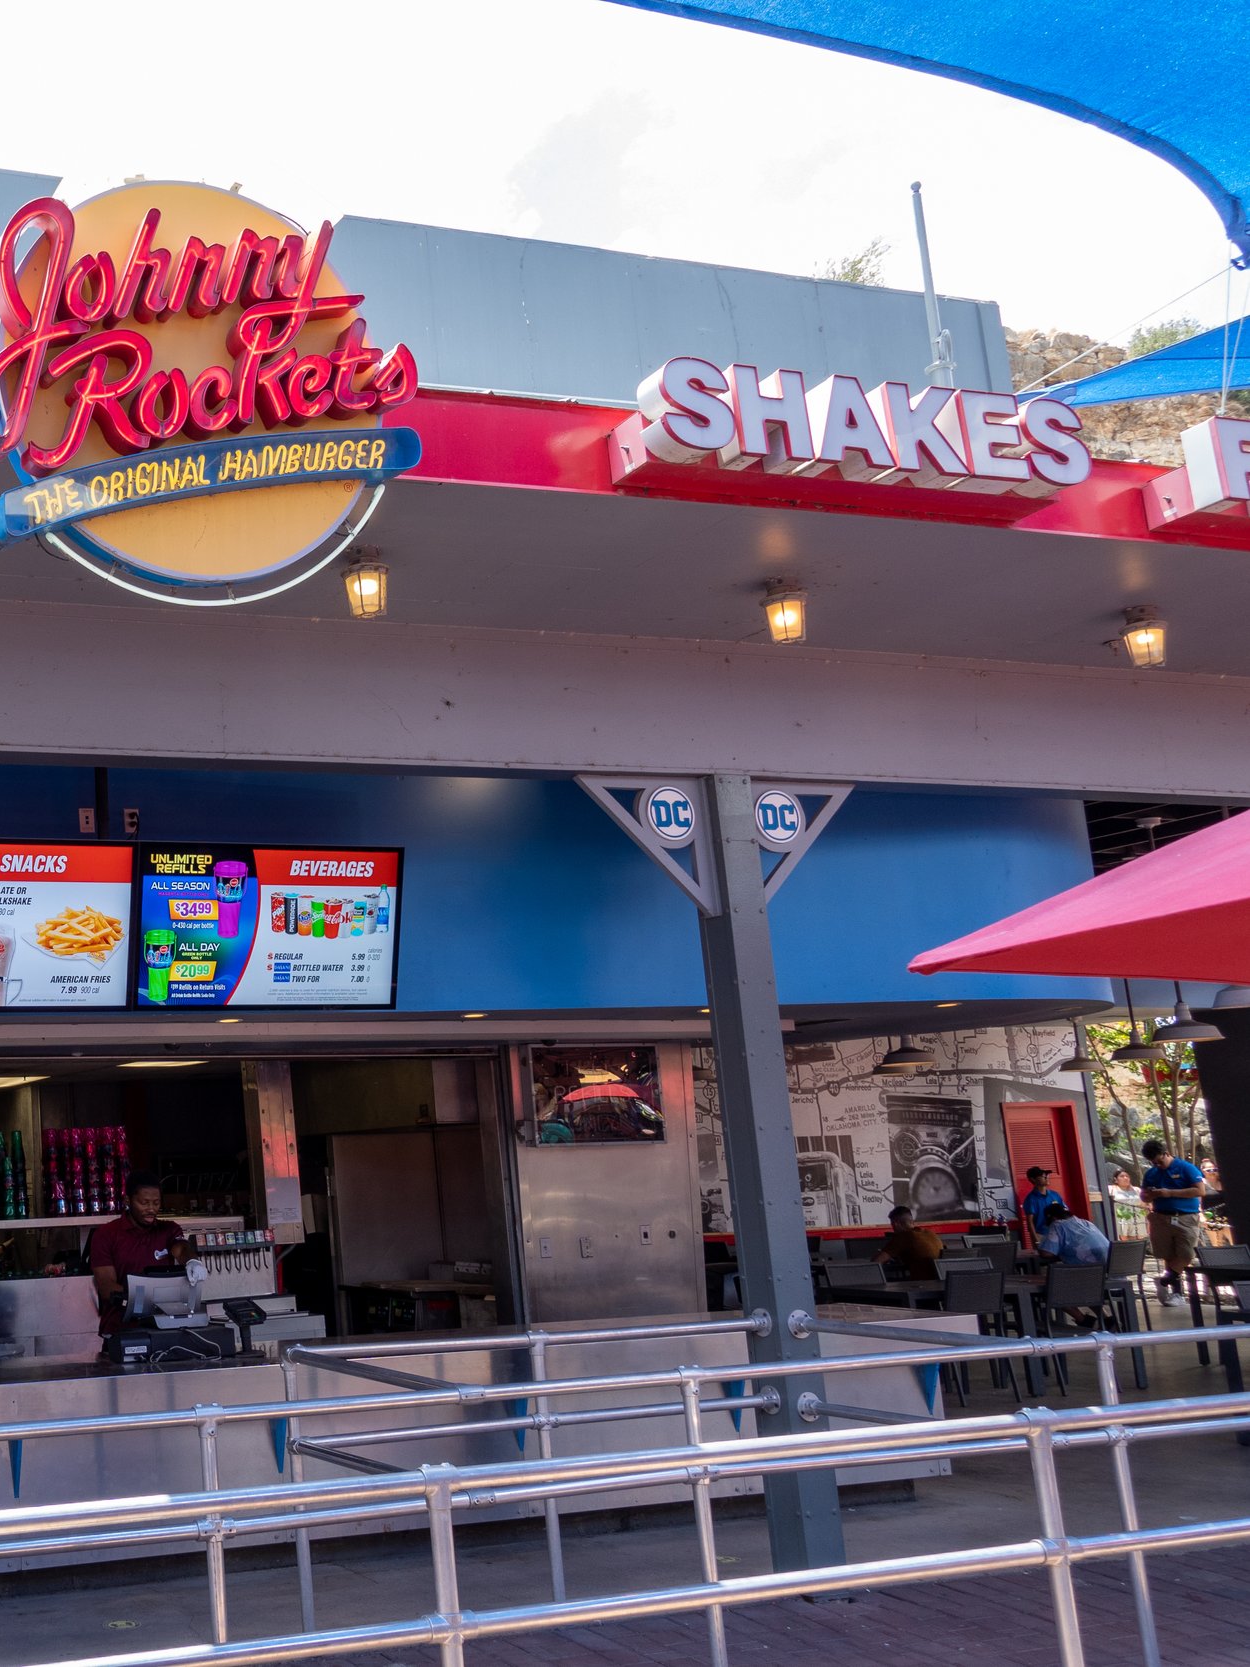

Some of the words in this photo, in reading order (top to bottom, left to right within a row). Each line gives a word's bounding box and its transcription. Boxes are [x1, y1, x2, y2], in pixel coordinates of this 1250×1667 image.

[22, 318, 418, 478] Rockets
[648, 356, 1092, 492] SHAKES
[23, 478, 83, 525] THE
[90, 454, 211, 508] ORIGINAL
[218, 439, 387, 482] HAMBURGER
[651, 799, 691, 828] DC
[758, 803, 797, 832] DC
[0, 855, 68, 873] SNACKS
[150, 853, 213, 865] UNLIMITED
[156, 864, 206, 874] REFILLS
[290, 860, 375, 877] BEVERAGES
[16, 887, 27, 895] OR
[151, 882, 169, 890] ALL
[171, 882, 210, 890] SEASON
[7, 908, 15, 916] cal
[179, 943, 199, 951] ALL
[200, 943, 220, 951] DAY
[50, 975, 88, 983] AMERICAN
[90, 975, 111, 983] FRIES
[61, 986, 77, 994] 7.99
[92, 986, 100, 994] cal
[920, 1036, 938, 1045] Magic
[923, 1046, 936, 1055] City
[791, 1096, 814, 1104] Jericho
[844, 1104, 876, 1114] AMARILLO
[825, 1121, 861, 1132] OKLAHOMA
[862, 1195, 883, 1203] Hedley
